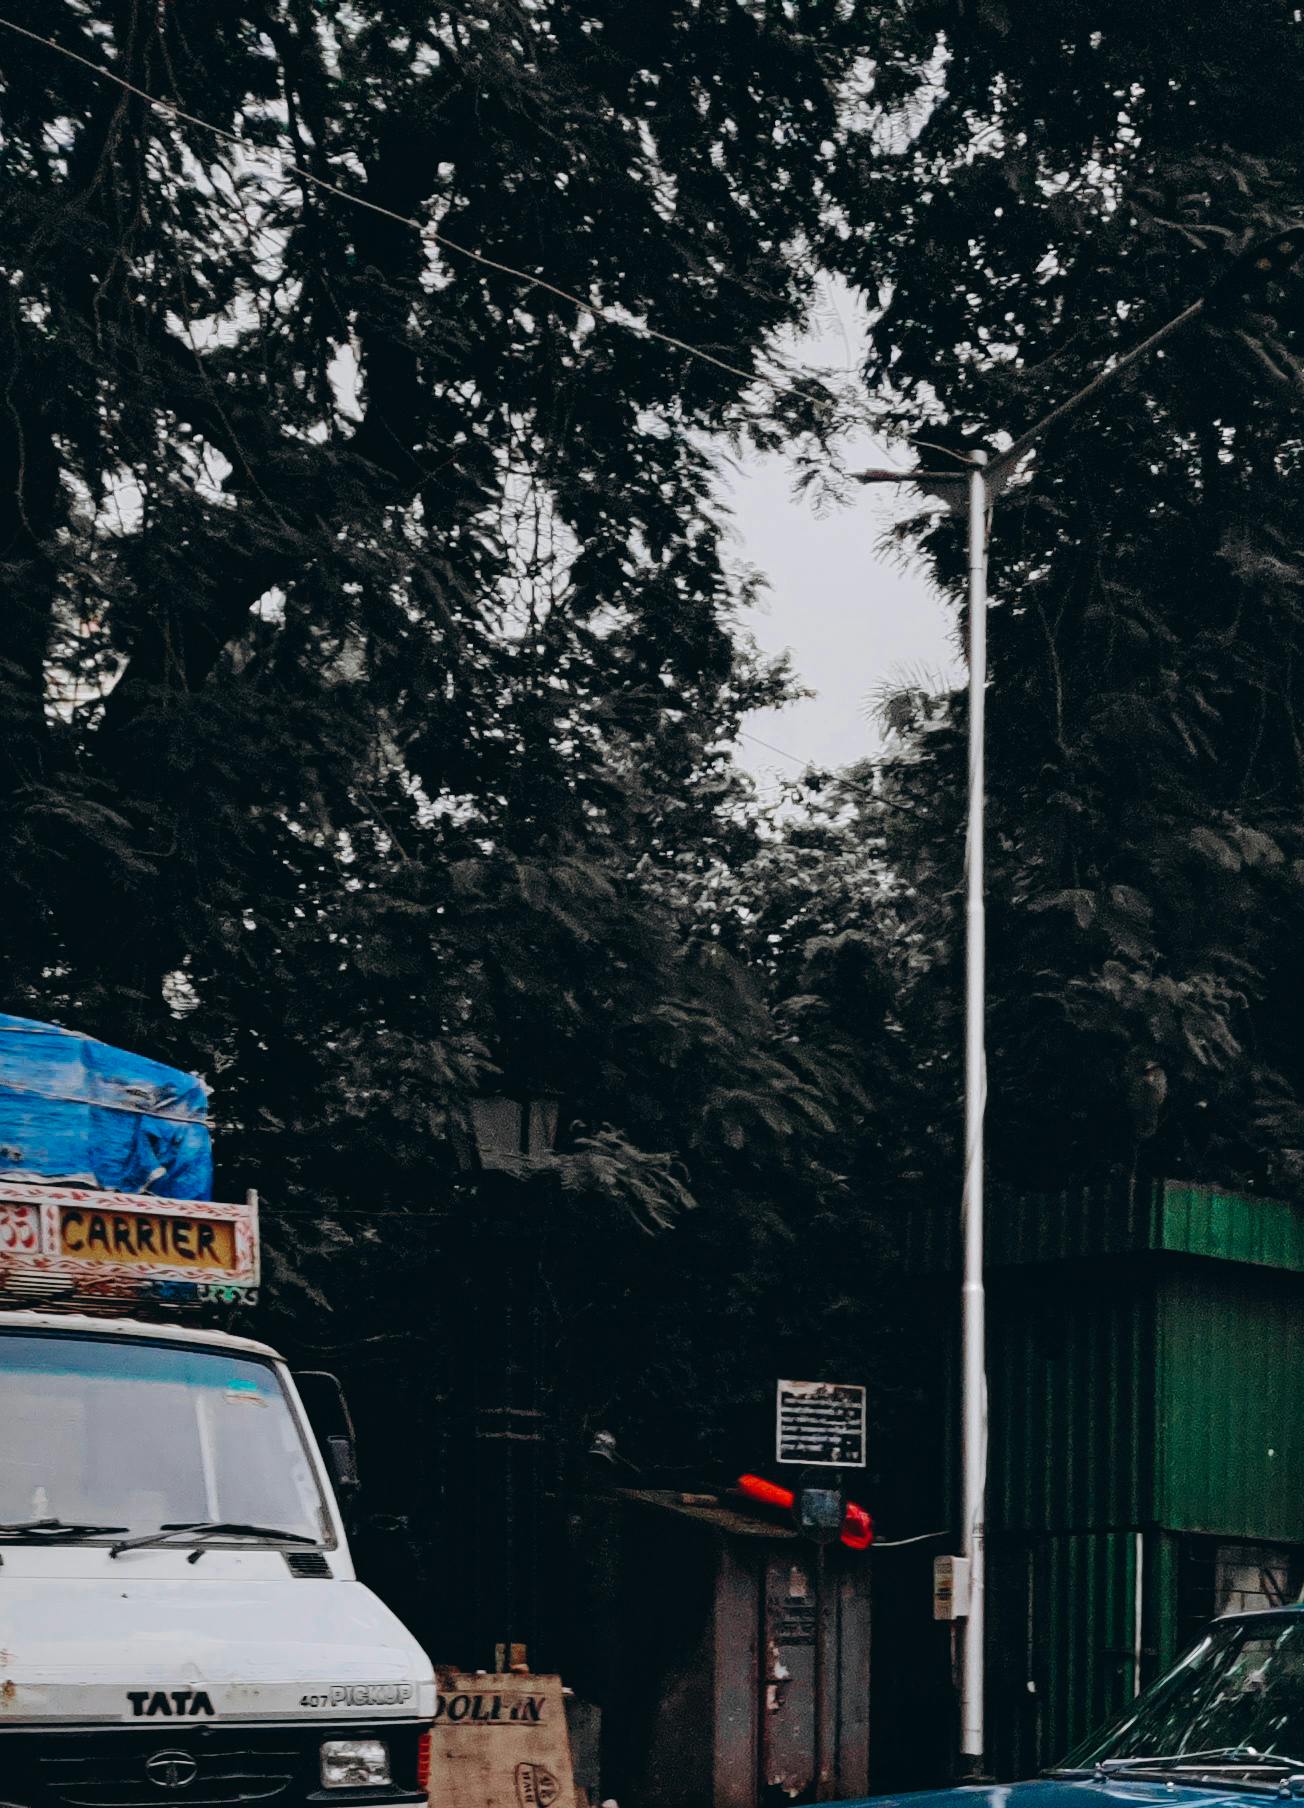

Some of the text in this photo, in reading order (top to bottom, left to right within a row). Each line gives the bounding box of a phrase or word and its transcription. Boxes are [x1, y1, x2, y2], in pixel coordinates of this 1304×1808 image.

[61, 1210, 222, 1265] CARRIER
[126, 1691, 216, 1716] TATA
[299, 1683, 413, 1708] 407 PICKUP
